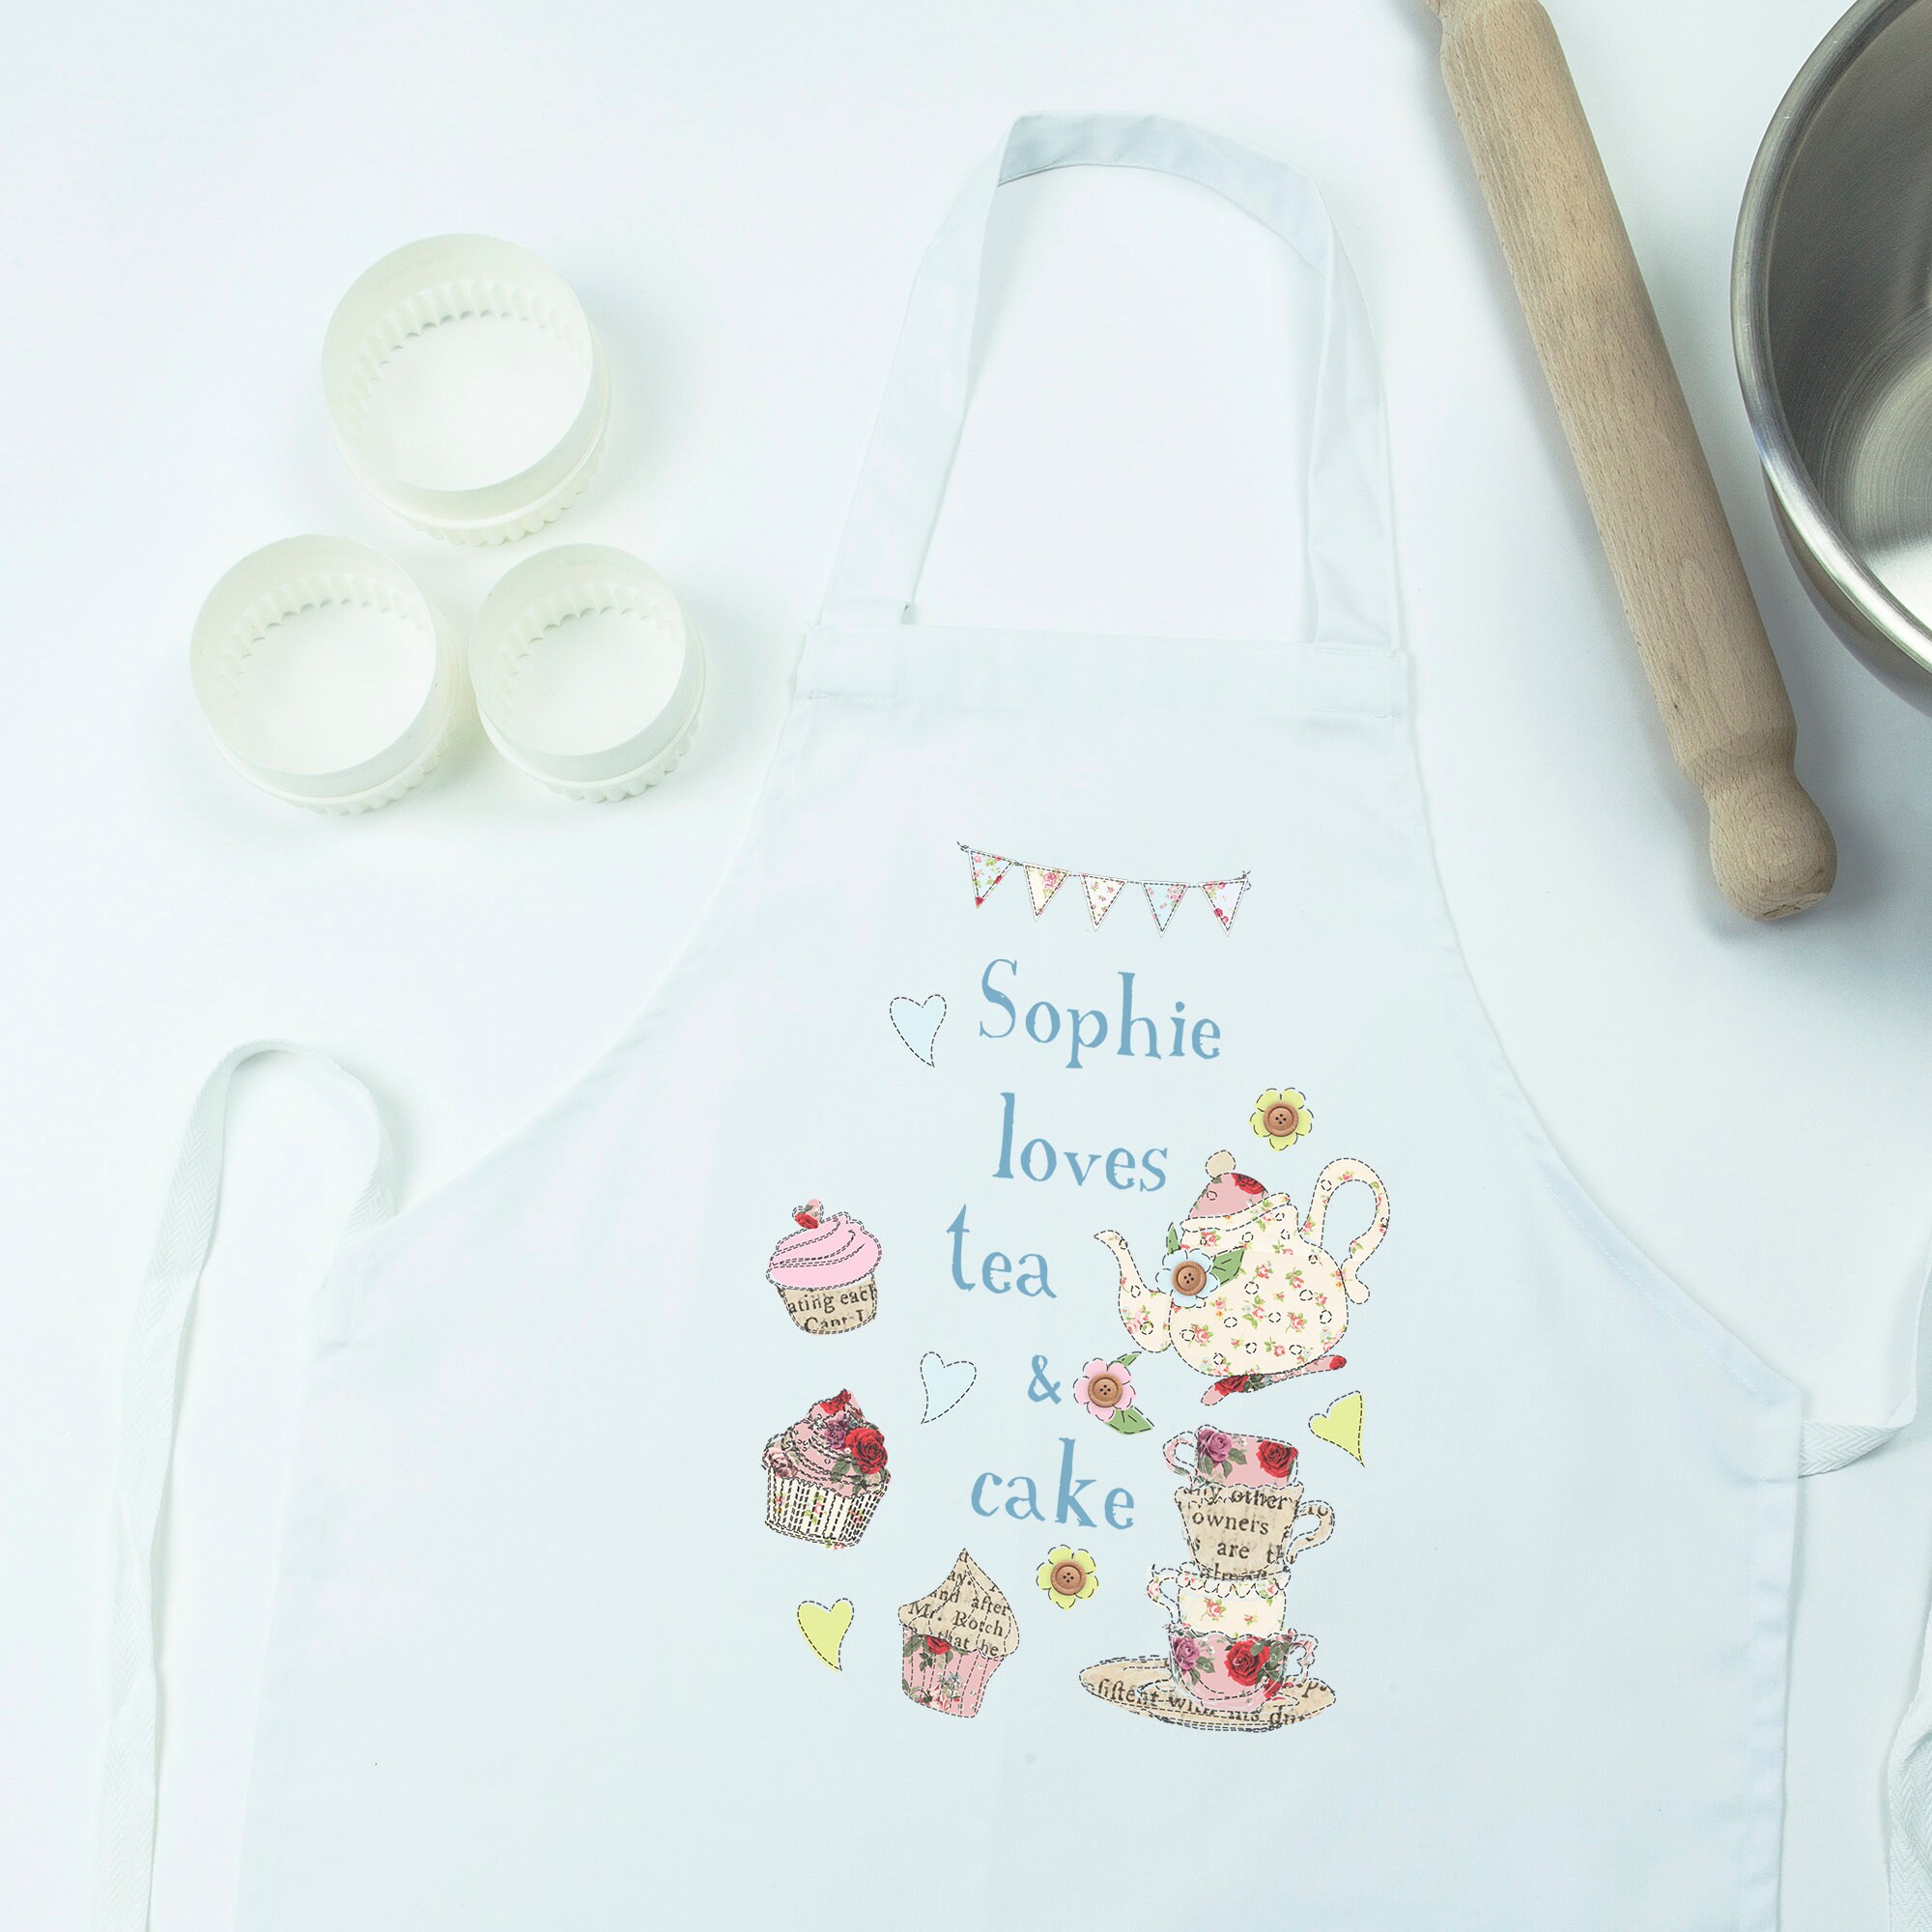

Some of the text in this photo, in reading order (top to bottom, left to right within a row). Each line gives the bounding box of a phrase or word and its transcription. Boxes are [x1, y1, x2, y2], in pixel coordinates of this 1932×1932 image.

[980, 958, 1221, 1069] Sophie
[993, 1093, 1168, 1192] loves
[947, 1205, 1058, 1299] tea
[1027, 1354, 1062, 1405] &
[971, 1437, 1135, 1530] cake
[1192, 1512, 1269, 1535] owners
[1217, 1542, 1250, 1560] are
[980, 1638, 1000, 1657] he
